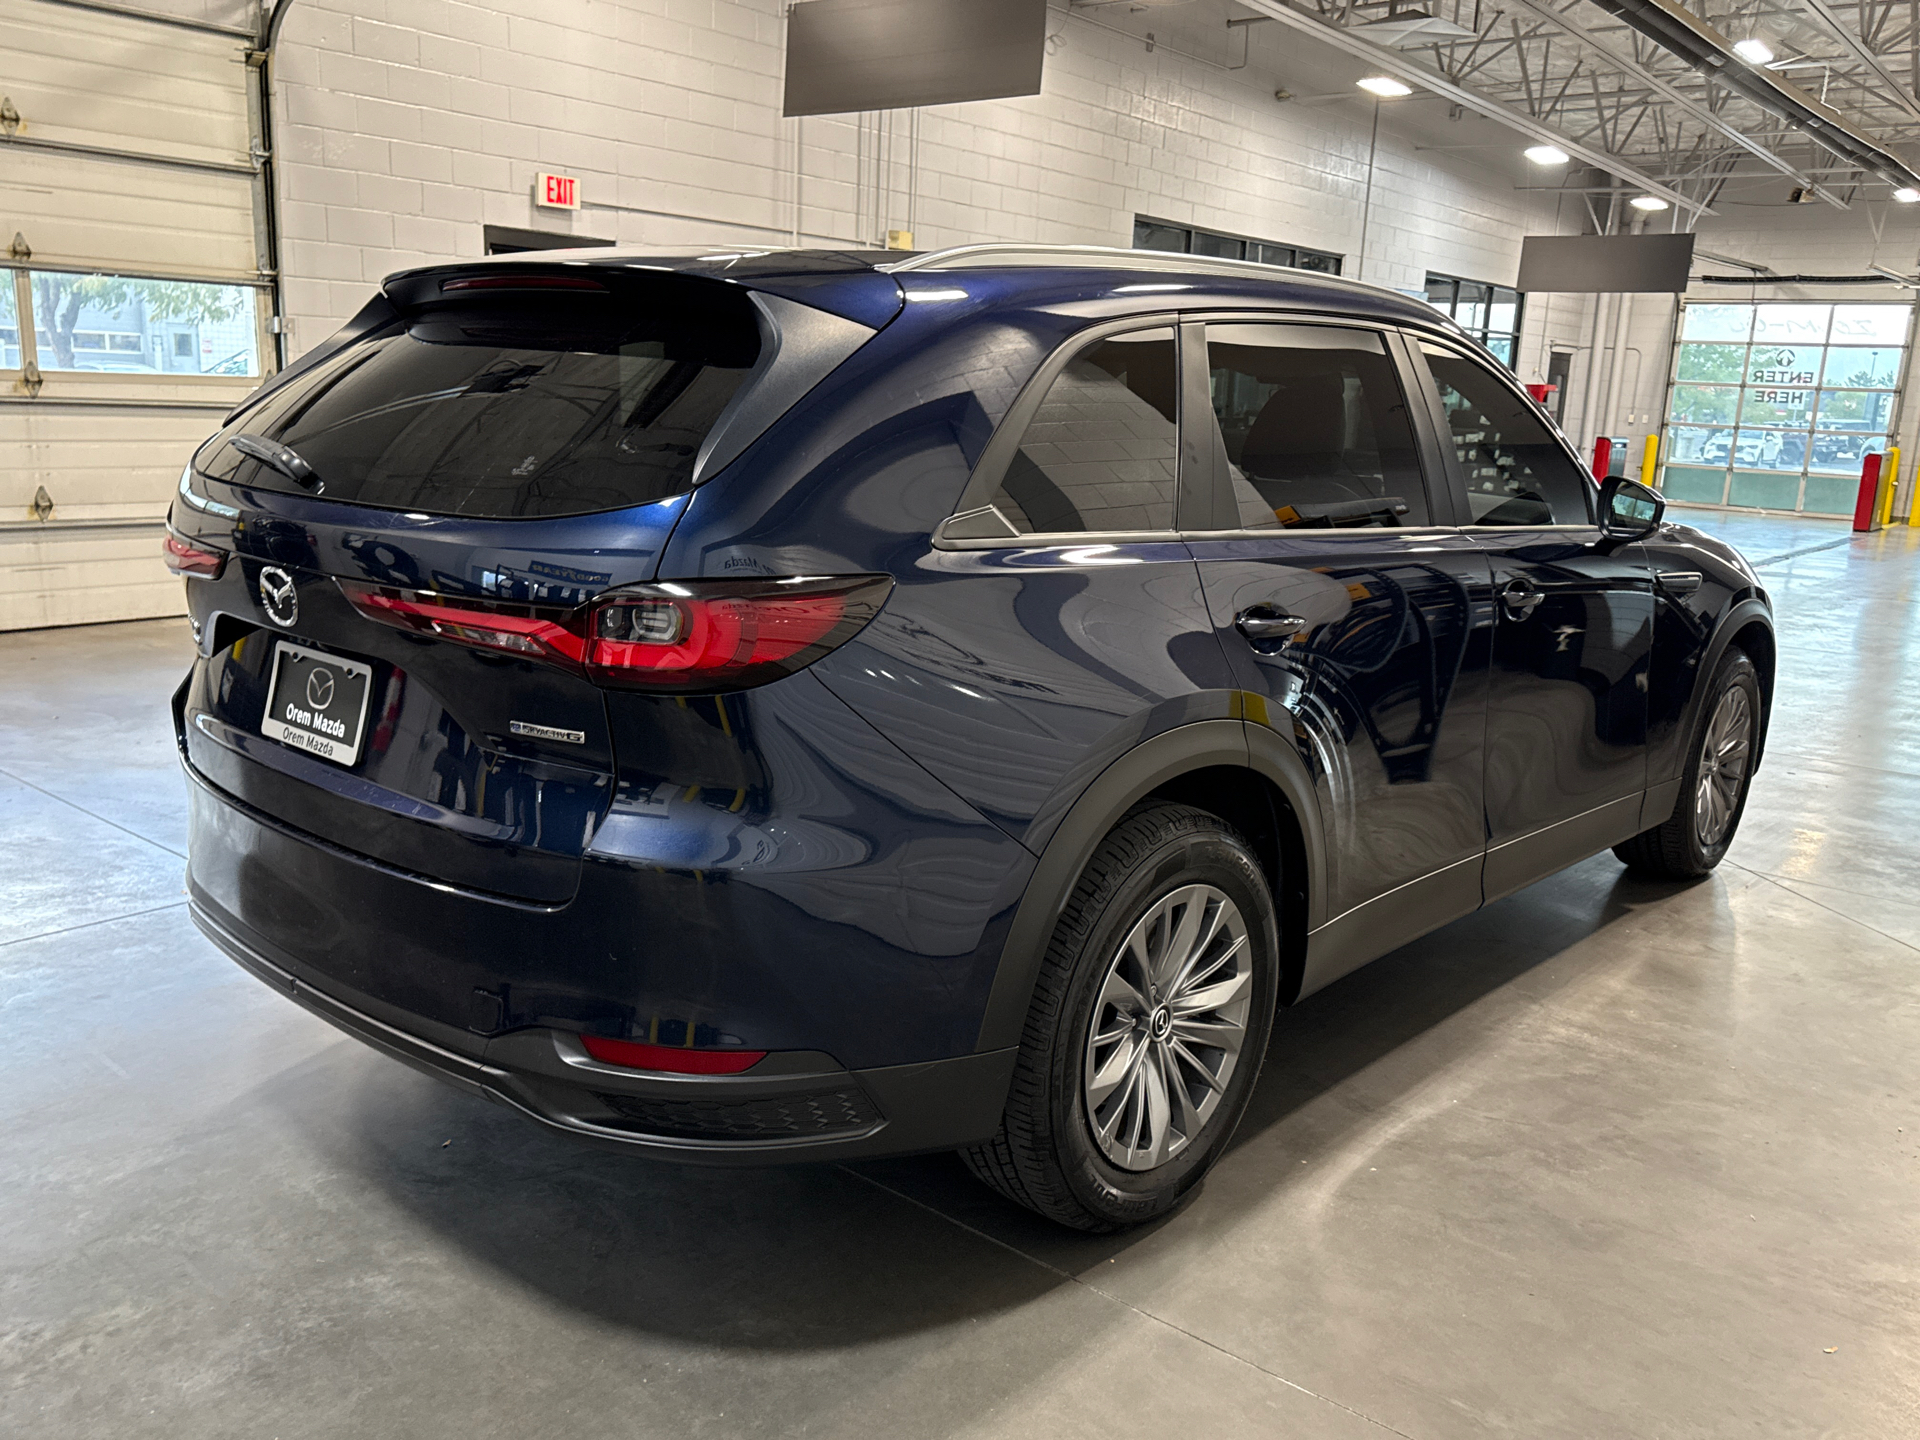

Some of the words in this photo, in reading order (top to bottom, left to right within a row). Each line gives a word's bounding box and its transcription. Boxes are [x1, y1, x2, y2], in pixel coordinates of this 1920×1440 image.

[547, 176, 574, 206] EXIT
[286, 703, 312, 726] Orem
[313, 711, 345, 738] Mazda
[283, 727, 305, 746] Orem
[305, 735, 334, 756] Mazda
